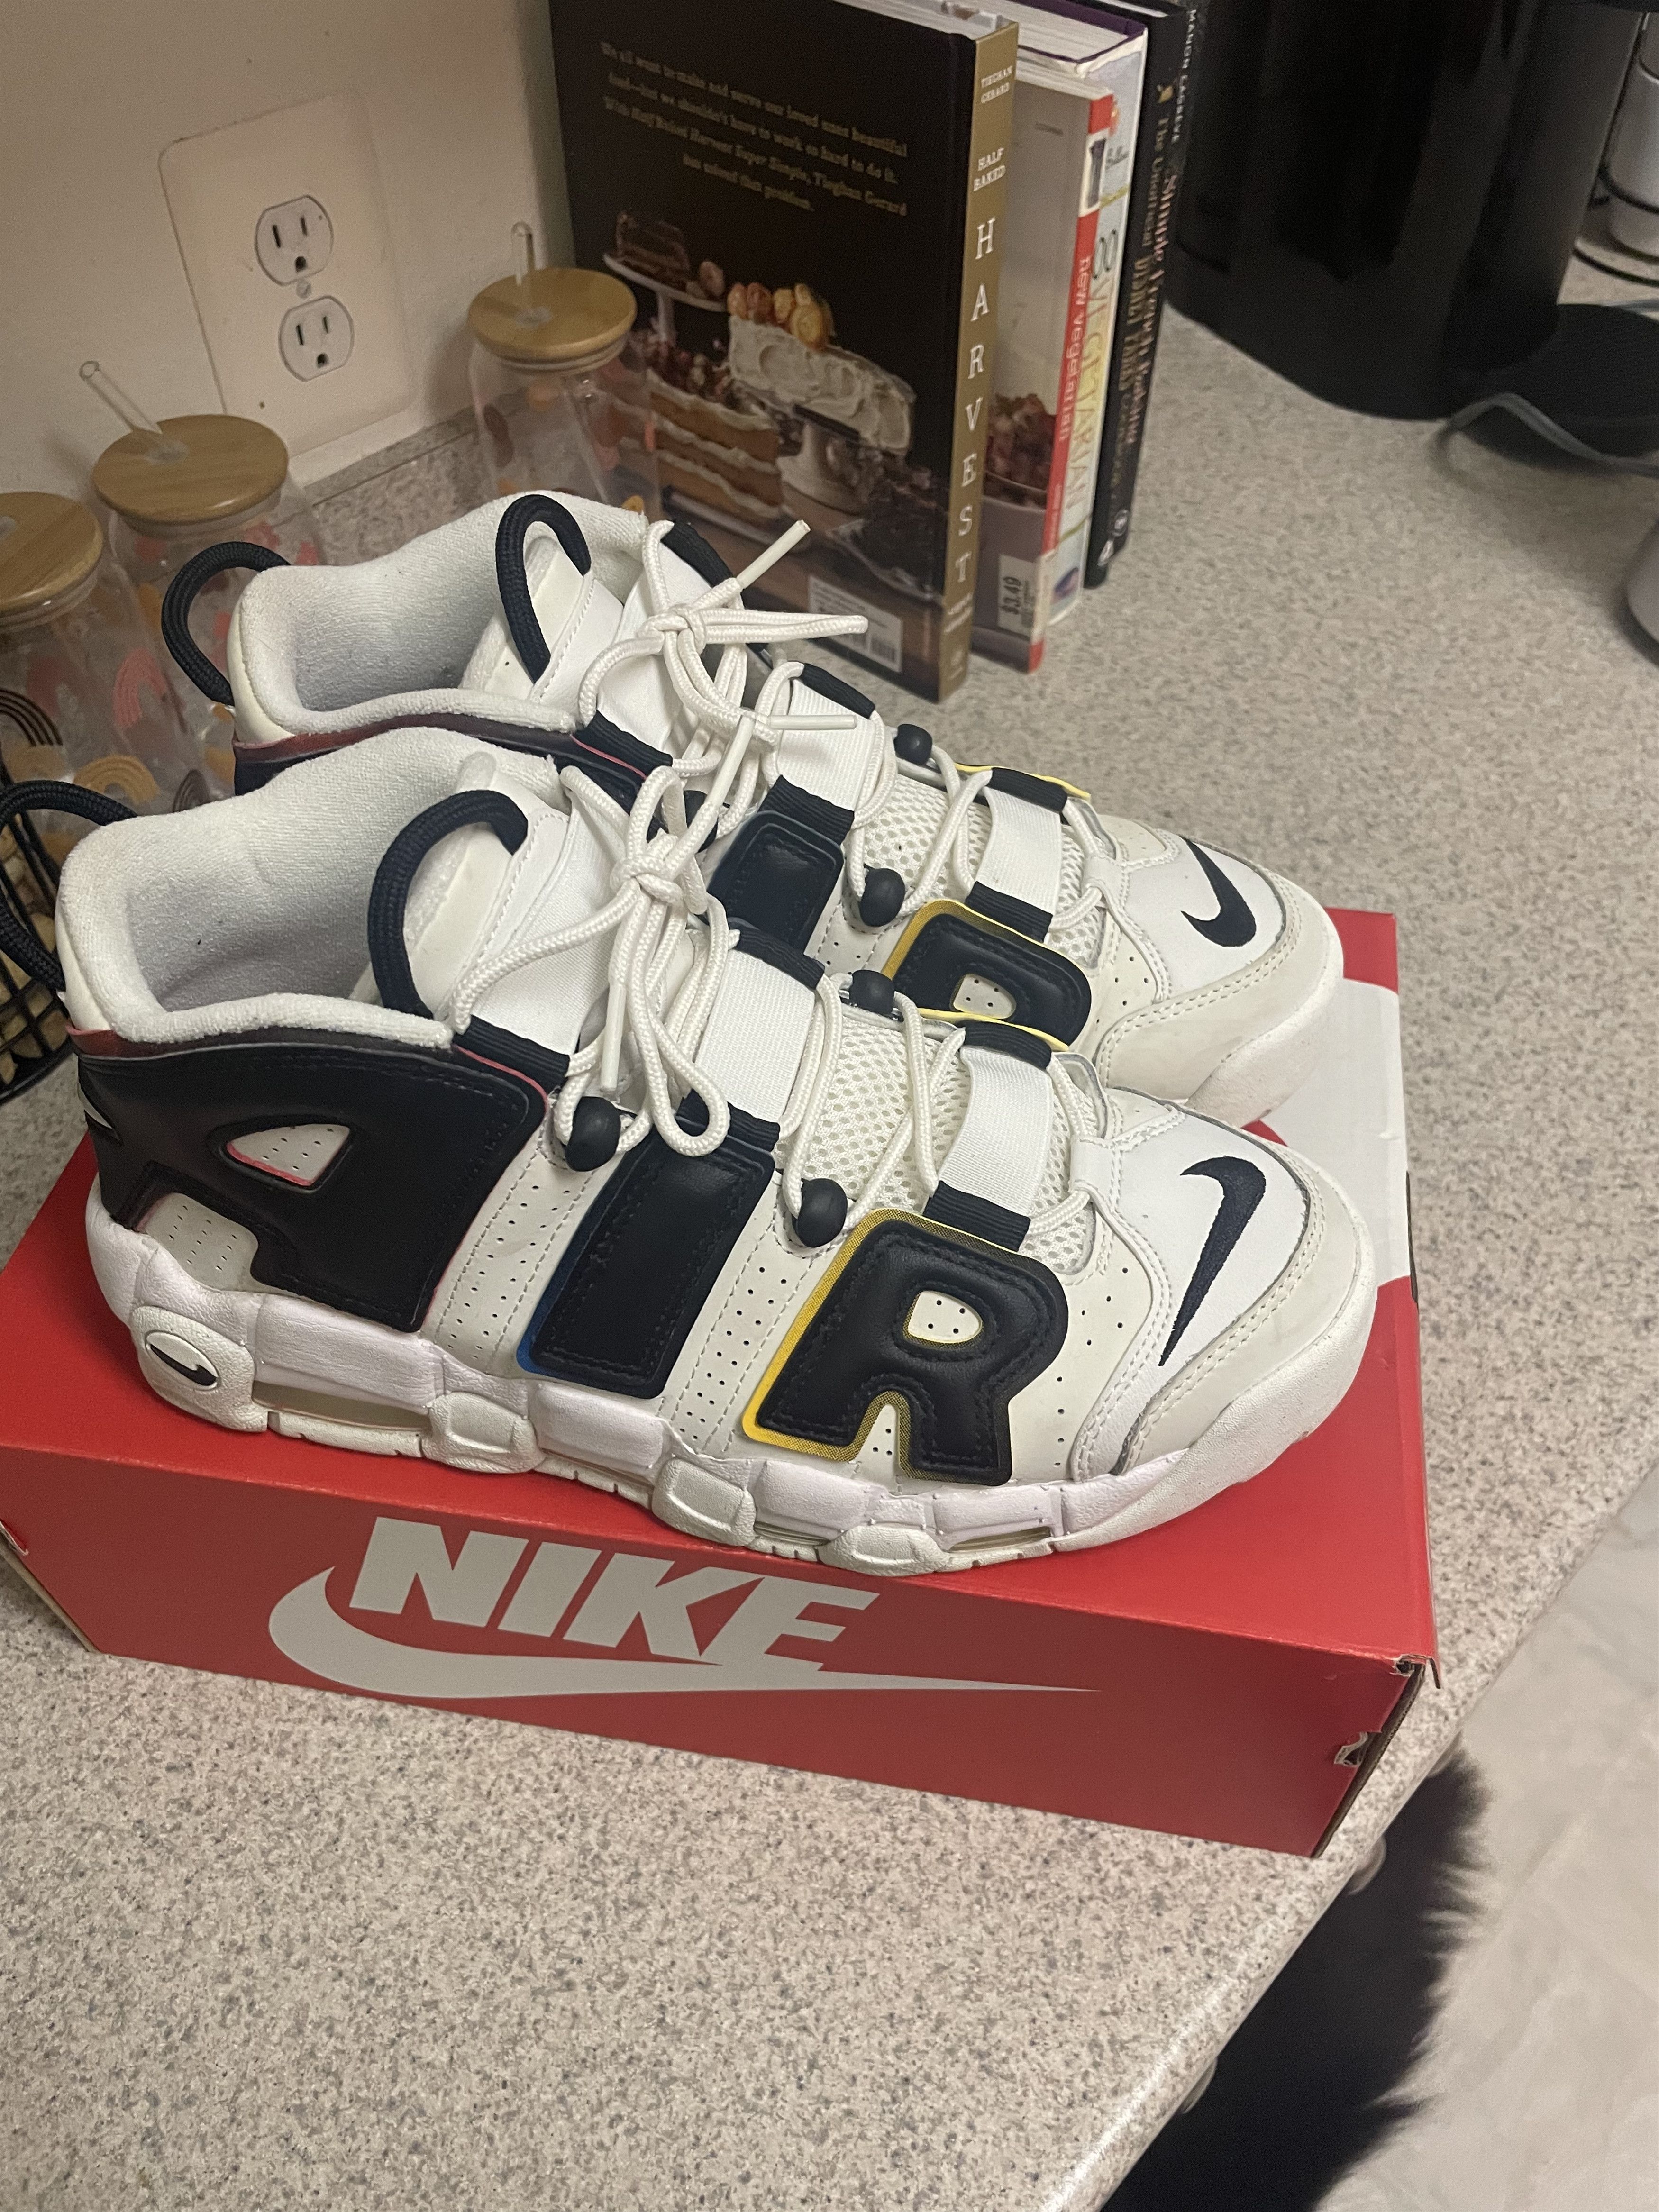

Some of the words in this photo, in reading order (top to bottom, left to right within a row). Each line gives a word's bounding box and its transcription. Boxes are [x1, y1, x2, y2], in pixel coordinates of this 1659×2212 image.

[977, 147, 1004, 171] HALF
[954, 217, 996, 583] HARVEST
[1001, 575, 1021, 615] $3.49
[349, 1517, 880, 1672] NIKE
